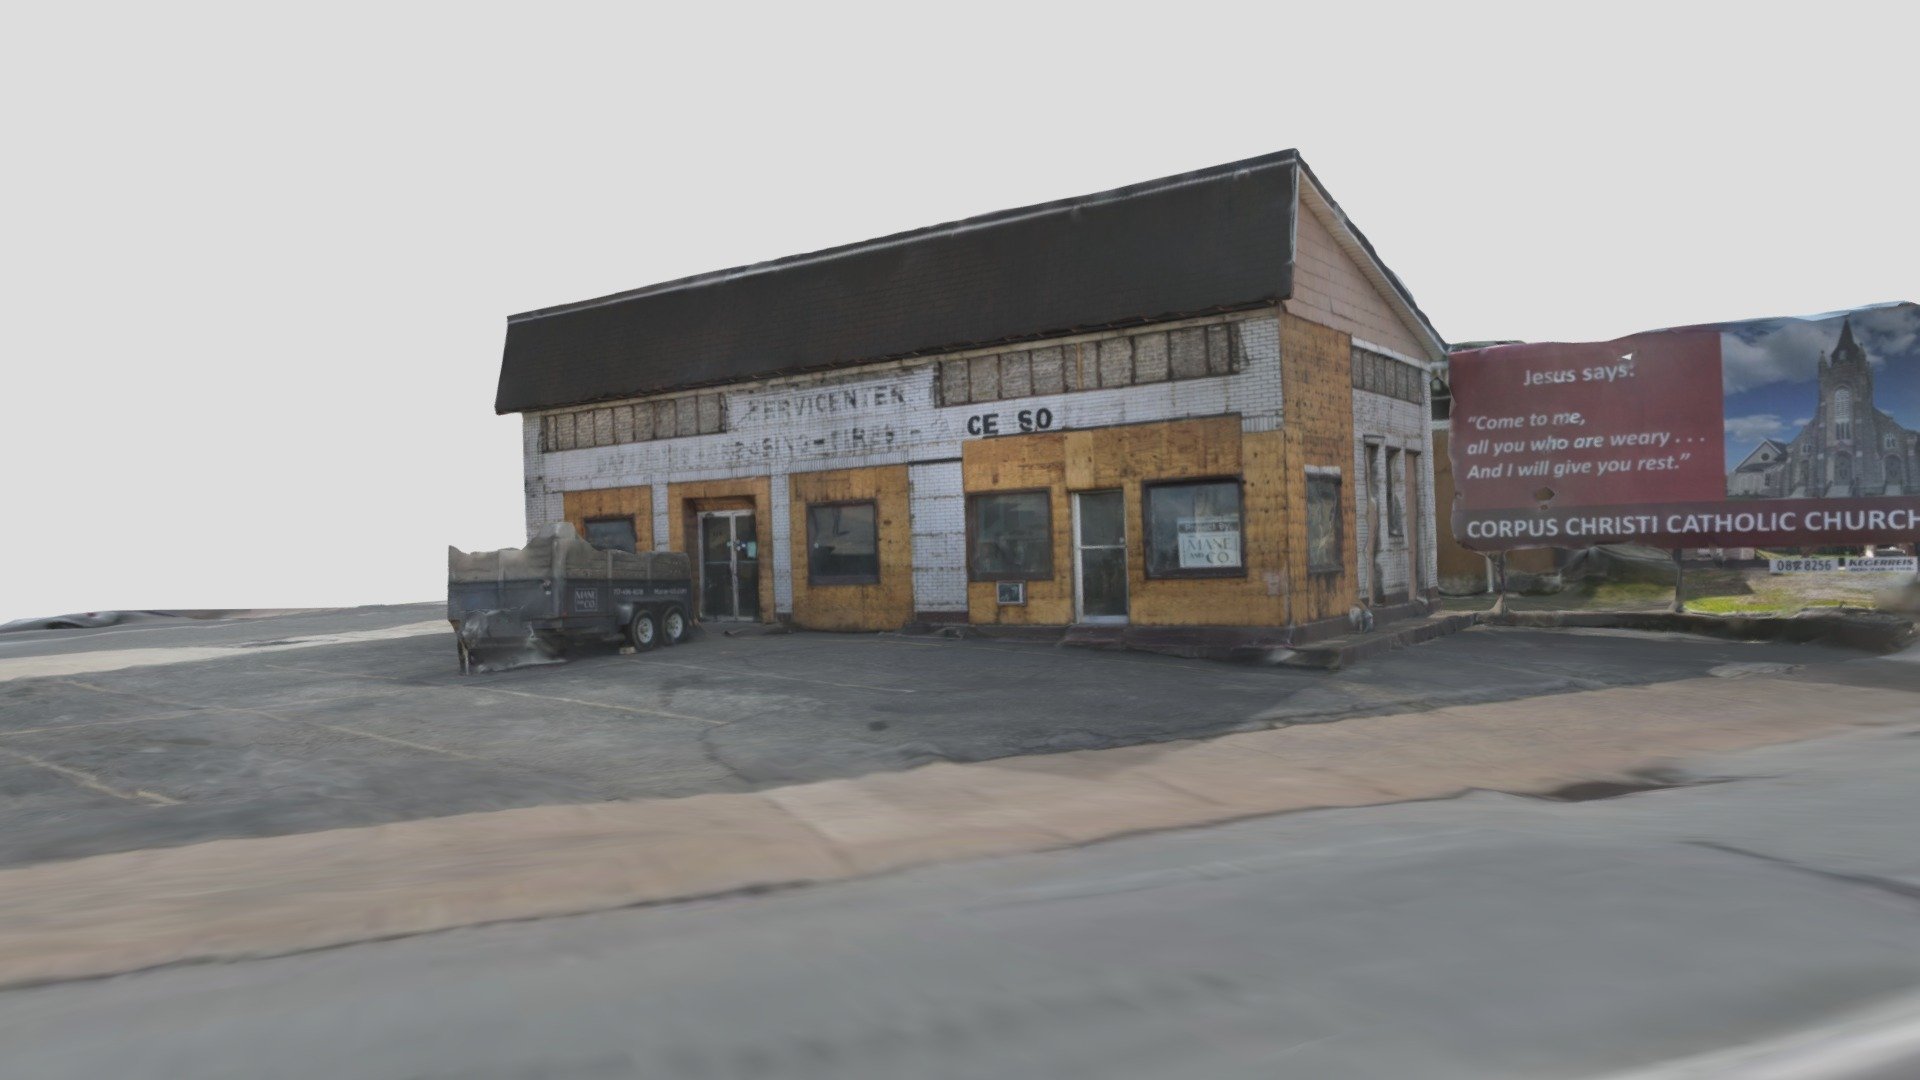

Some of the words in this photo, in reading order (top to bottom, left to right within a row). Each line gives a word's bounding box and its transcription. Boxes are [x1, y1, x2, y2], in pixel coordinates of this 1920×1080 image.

[1523, 369, 1576, 386] Jesus
[1582, 363, 1636, 382] says:
[967, 413, 999, 435] CE
[1018, 407, 1053, 432] SO
[1468, 414, 1524, 430] “Come
[1530, 413, 1547, 427] to
[1552, 411, 1586, 426] me,
[1467, 439, 1488, 455] all
[1494, 440, 1525, 457] you
[1530, 435, 1568, 452] who
[1573, 434, 1603, 449] are
[1610, 431, 1670, 447] weary
[1467, 463, 1503, 480] And
[1507, 464, 1514, 477] I
[1518, 461, 1549, 476] will
[1553, 459, 1591, 478] give
[1597, 458, 1632, 475] you
[1466, 518, 1559, 538] CORPUS
[1565, 515, 1658, 536] CHRISTI
[1666, 512, 1796, 533] CATHOLIC
